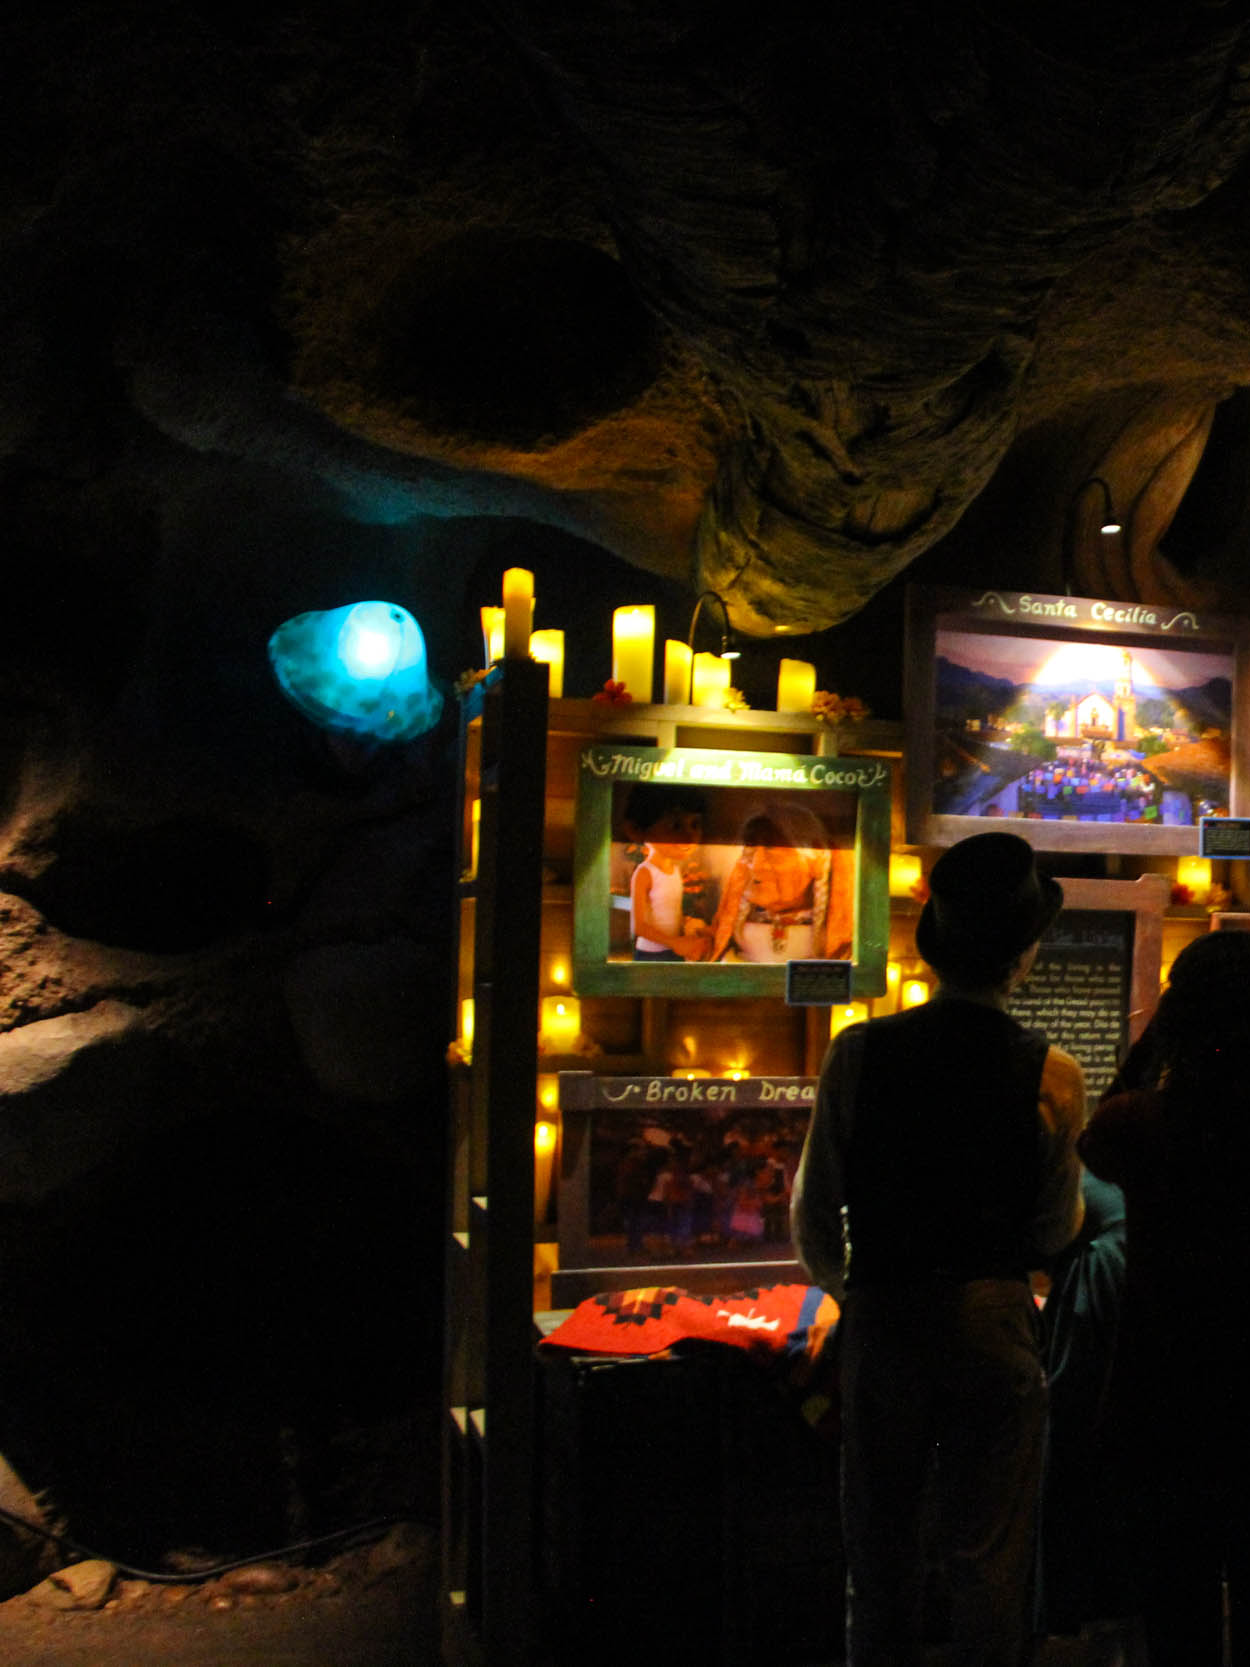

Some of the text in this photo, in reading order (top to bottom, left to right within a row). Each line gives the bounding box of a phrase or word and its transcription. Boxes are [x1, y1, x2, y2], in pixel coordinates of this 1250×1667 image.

[1019, 595, 1158, 625] Santa Cecilia
[612, 753, 853, 784] Miguel and Mamá Coco
[645, 1079, 817, 1103] Broken Drea
